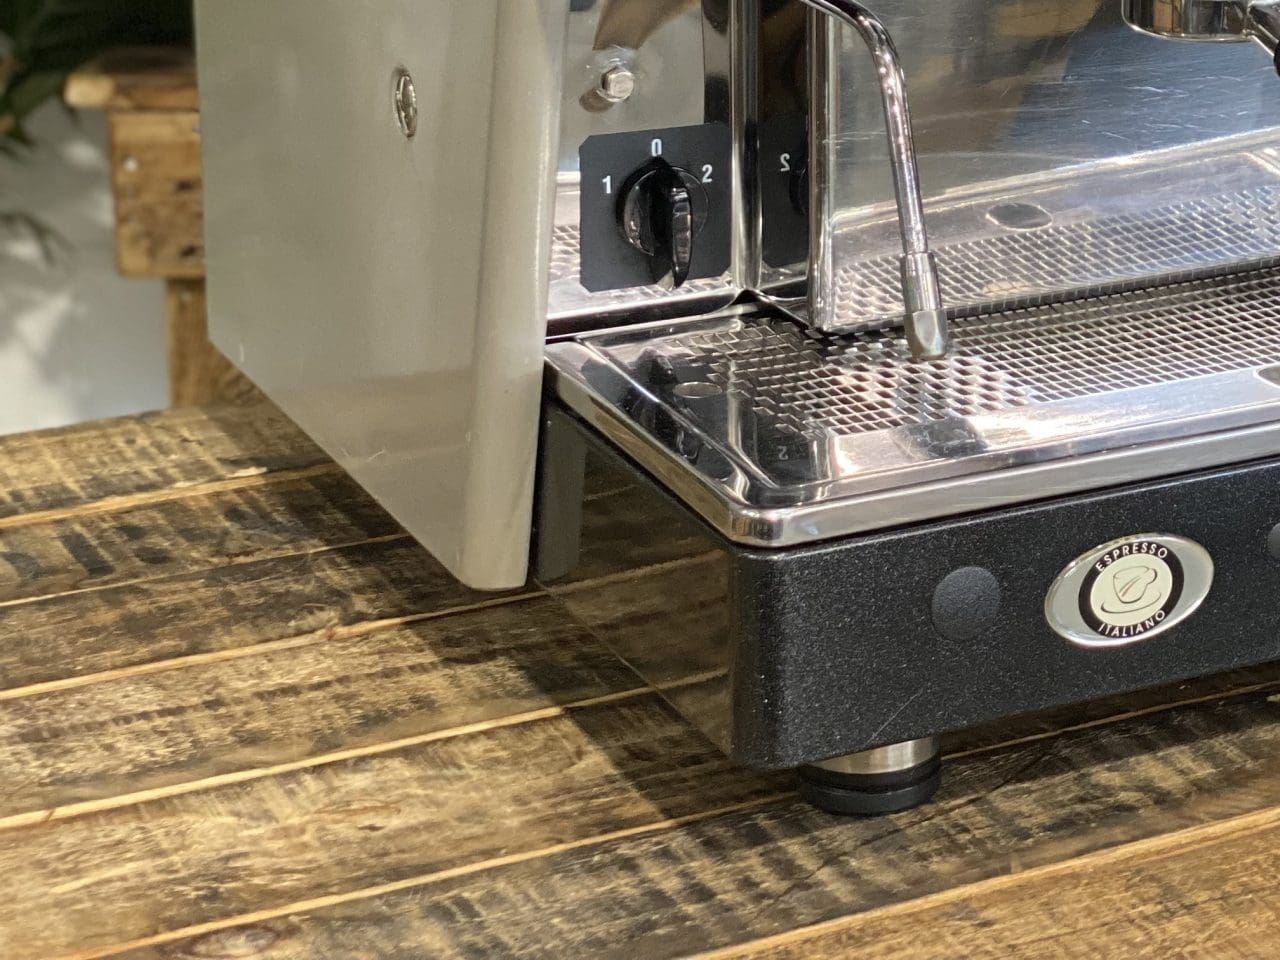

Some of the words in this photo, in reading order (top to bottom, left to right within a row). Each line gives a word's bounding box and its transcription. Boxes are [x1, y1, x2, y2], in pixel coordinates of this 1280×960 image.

[651, 138, 662, 157] 0
[701, 164, 713, 183] 2
[601, 175, 612, 194] 1
[1095, 542, 1169, 572] ESPRESSO
[1098, 609, 1166, 637] ITALIANO
